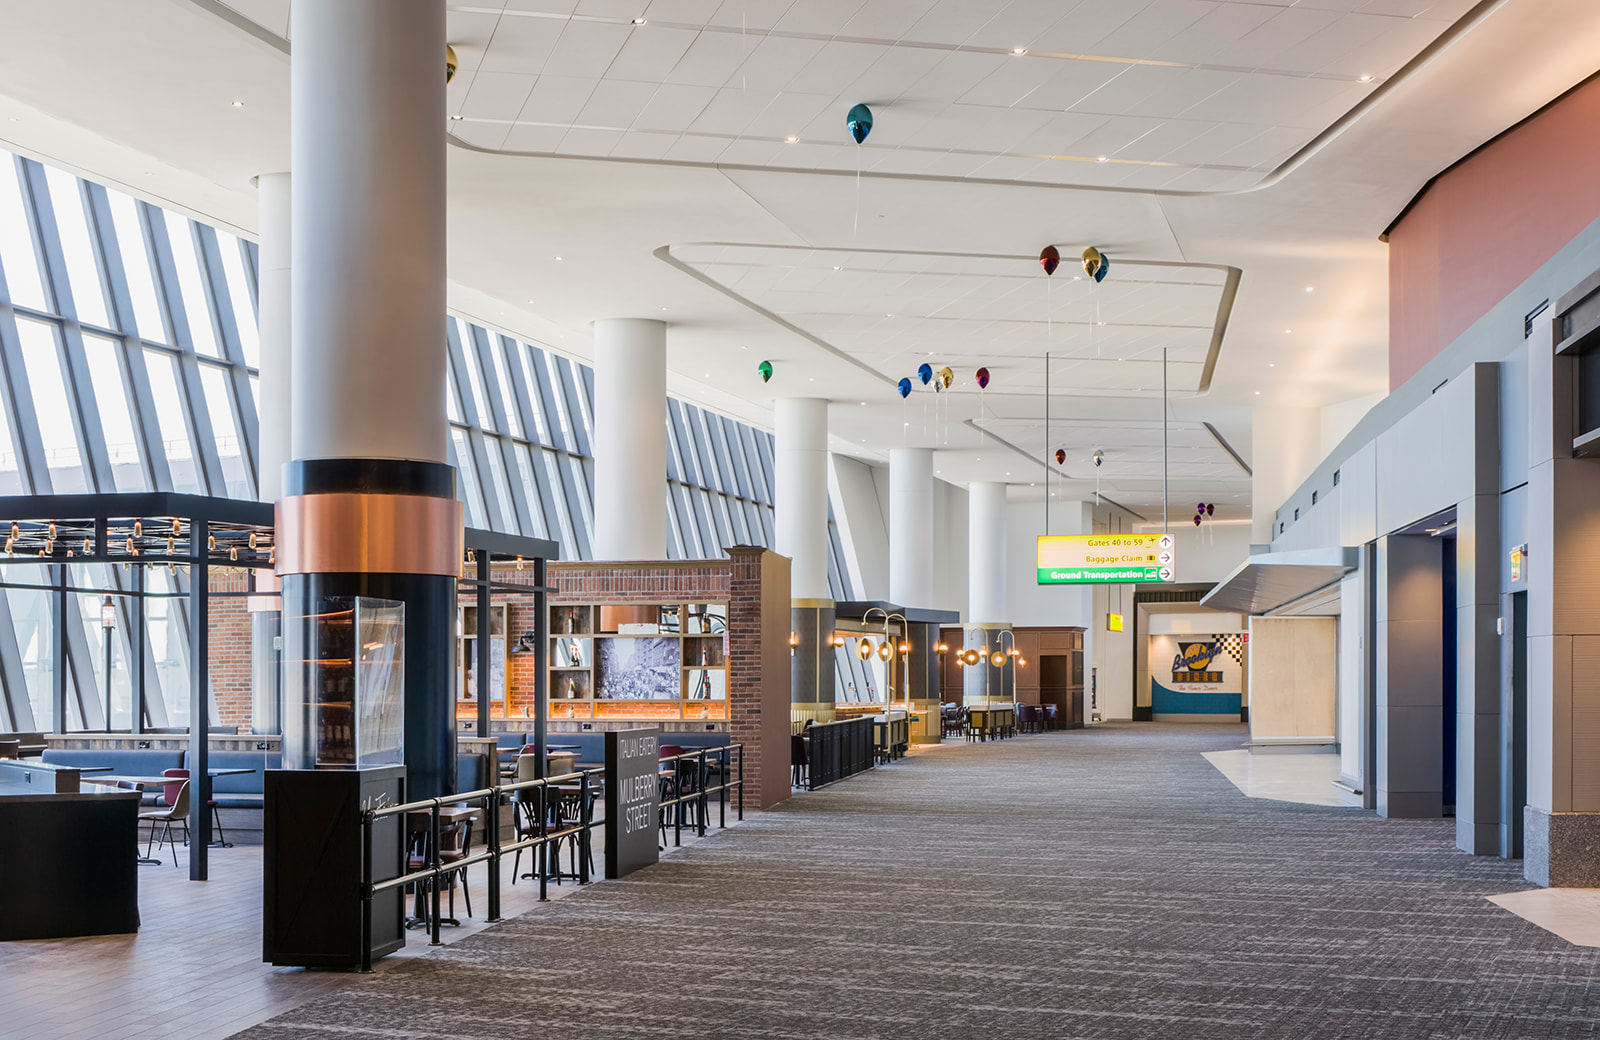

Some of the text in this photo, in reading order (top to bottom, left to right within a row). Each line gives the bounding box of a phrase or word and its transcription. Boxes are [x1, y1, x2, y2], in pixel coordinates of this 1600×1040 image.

[1087, 539, 1110, 547] Gates
[1123, 538, 1131, 546] to
[1134, 538, 1143, 546] 59
[1085, 555, 1119, 564] Baggage
[1051, 571, 1143, 580] Ground Transportation
[1172, 643, 1222, 671] Brooklyn
[620, 736, 657, 759] ITALIAN EATERY
[620, 773, 657, 805] MULBERRY
[626, 802, 652, 834] STREET
